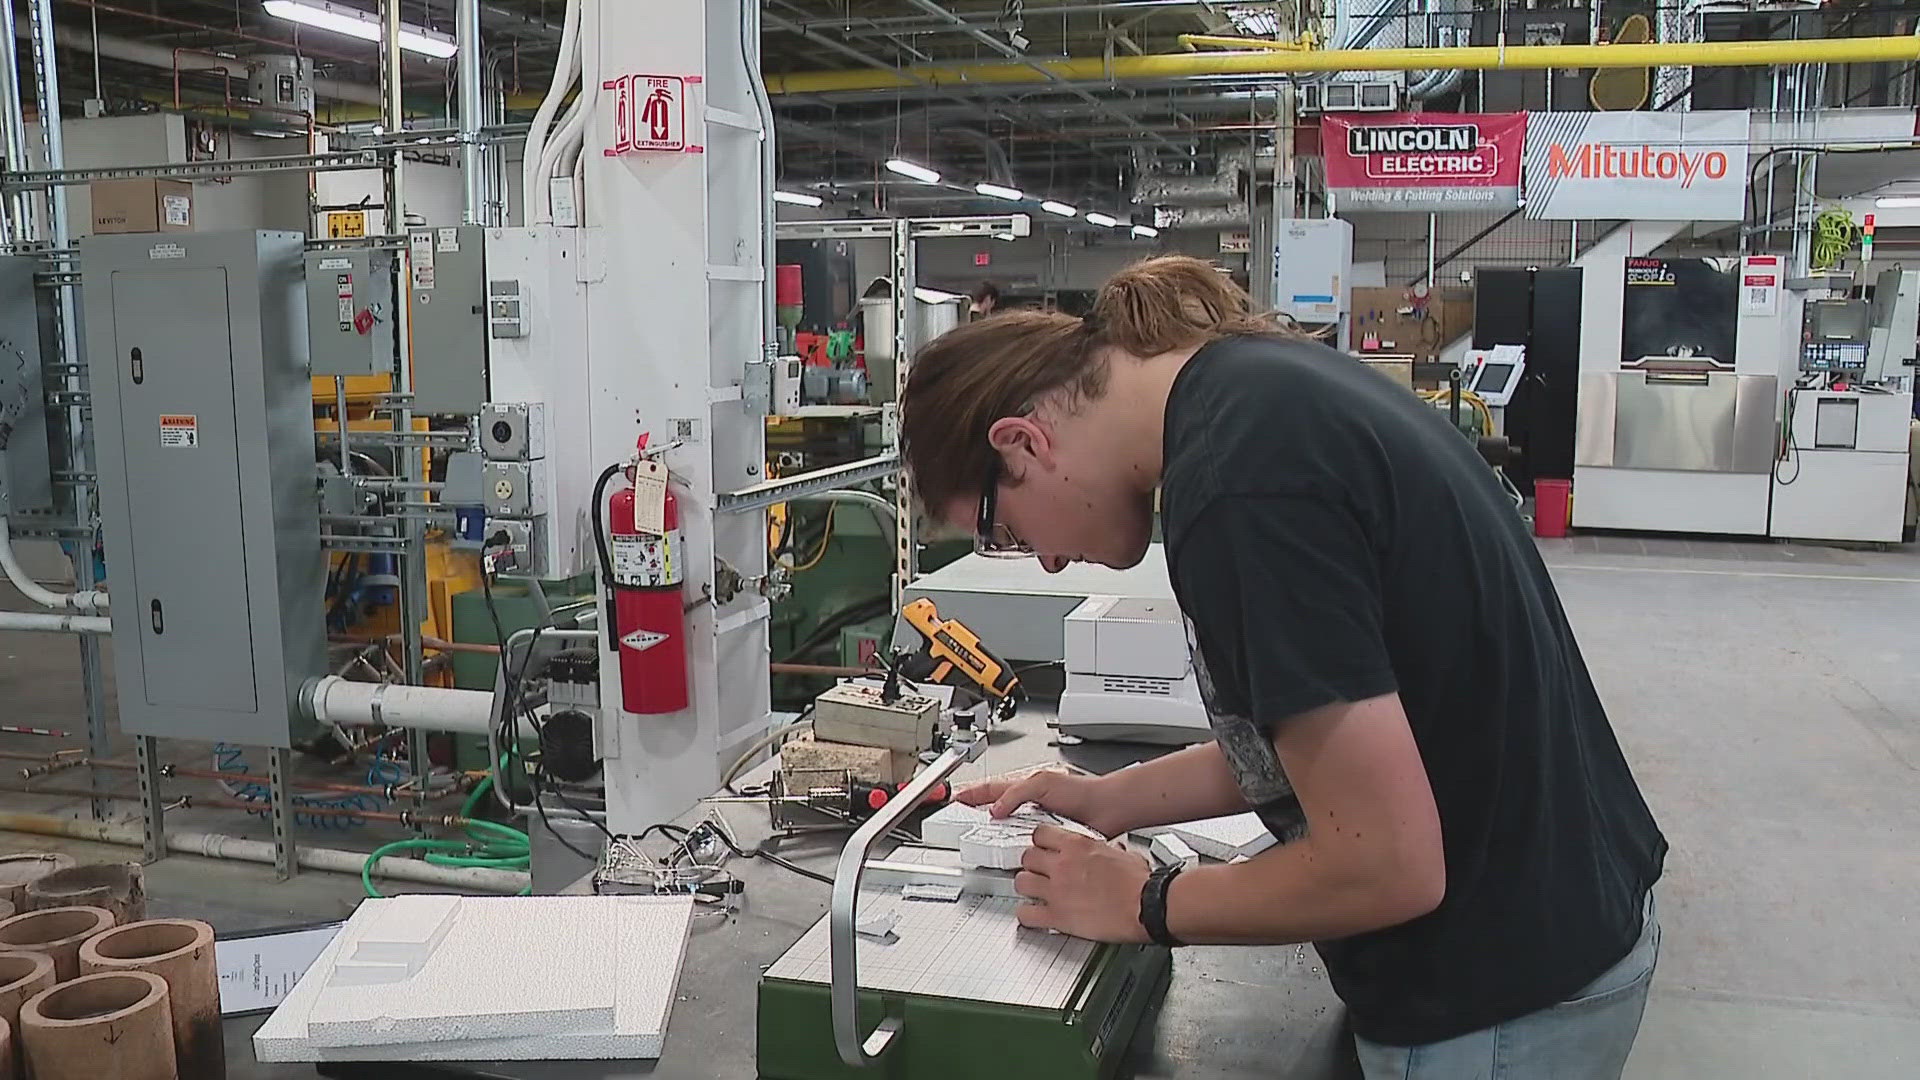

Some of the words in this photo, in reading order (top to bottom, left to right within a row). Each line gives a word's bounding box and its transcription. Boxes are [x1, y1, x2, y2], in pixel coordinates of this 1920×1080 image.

[647, 78, 669, 88] FIRE
[1355, 129, 1470, 152] LINCOLN
[1382, 156, 1483, 173] ELECTRIC
[1549, 143, 1728, 189] Mitutoyo
[1350, 190, 1391, 203] Welding
[1394, 190, 1401, 201] &
[1405, 190, 1443, 202] Cutting
[1446, 189, 1495, 201] Solutions
